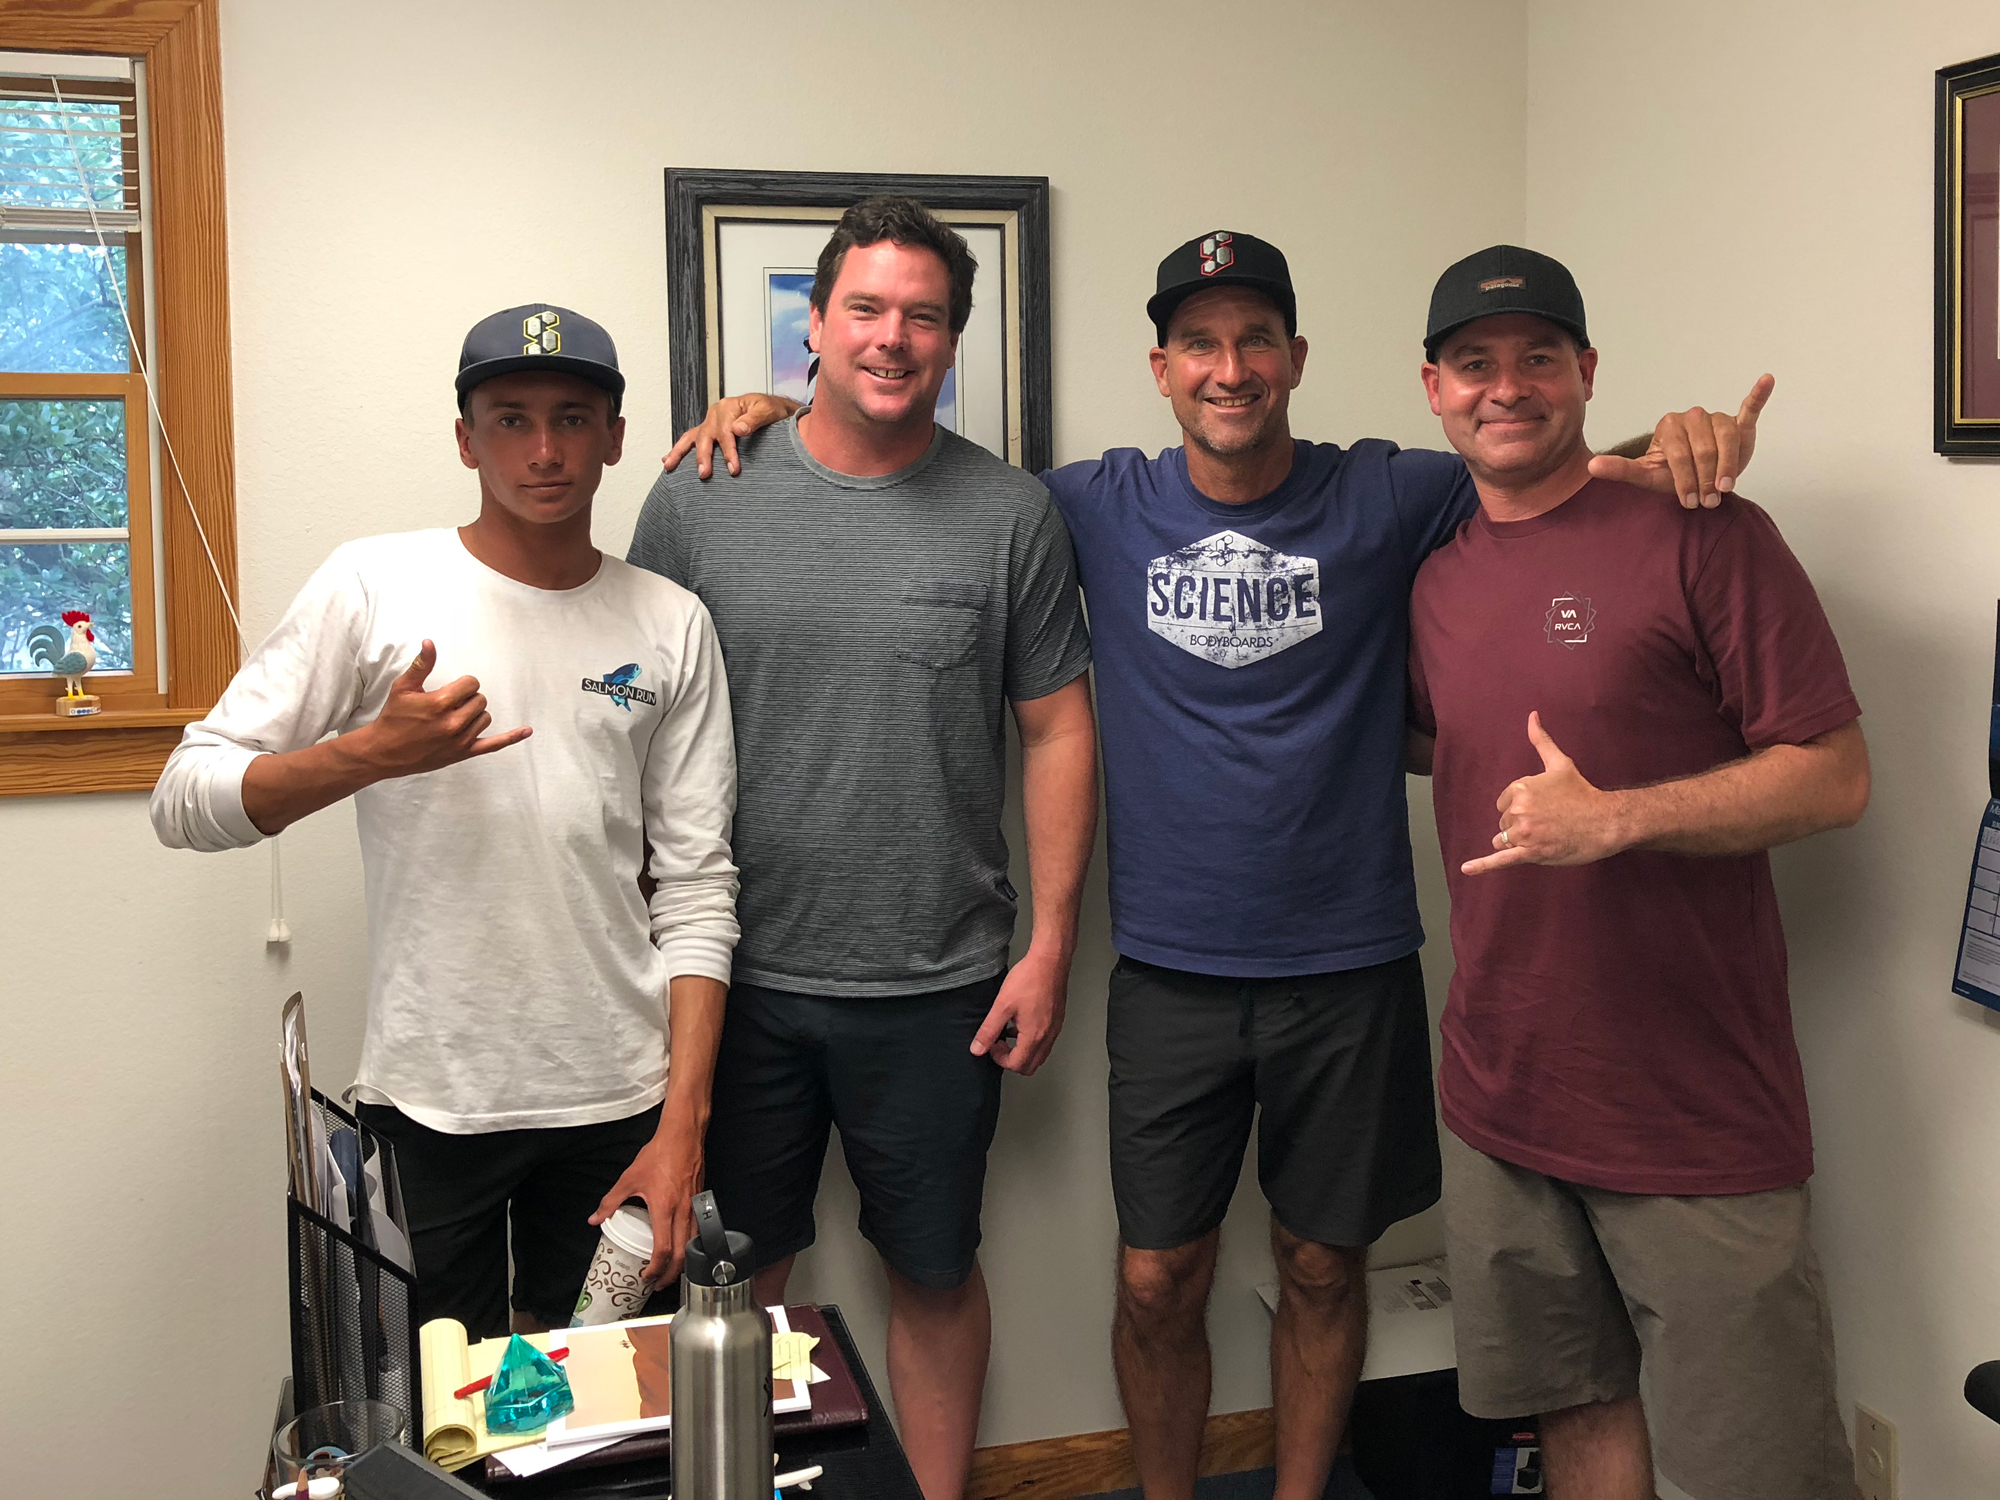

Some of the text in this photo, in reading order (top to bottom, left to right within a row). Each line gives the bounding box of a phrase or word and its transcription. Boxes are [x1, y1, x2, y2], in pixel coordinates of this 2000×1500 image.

[1150, 572, 1317, 623] SCIENCE
[1560, 609, 1577, 619] VA
[1554, 622, 1581, 631] RVCA
[1189, 634, 1274, 648] BODYBOARDS
[584, 679, 656, 705] SALMON RUN
